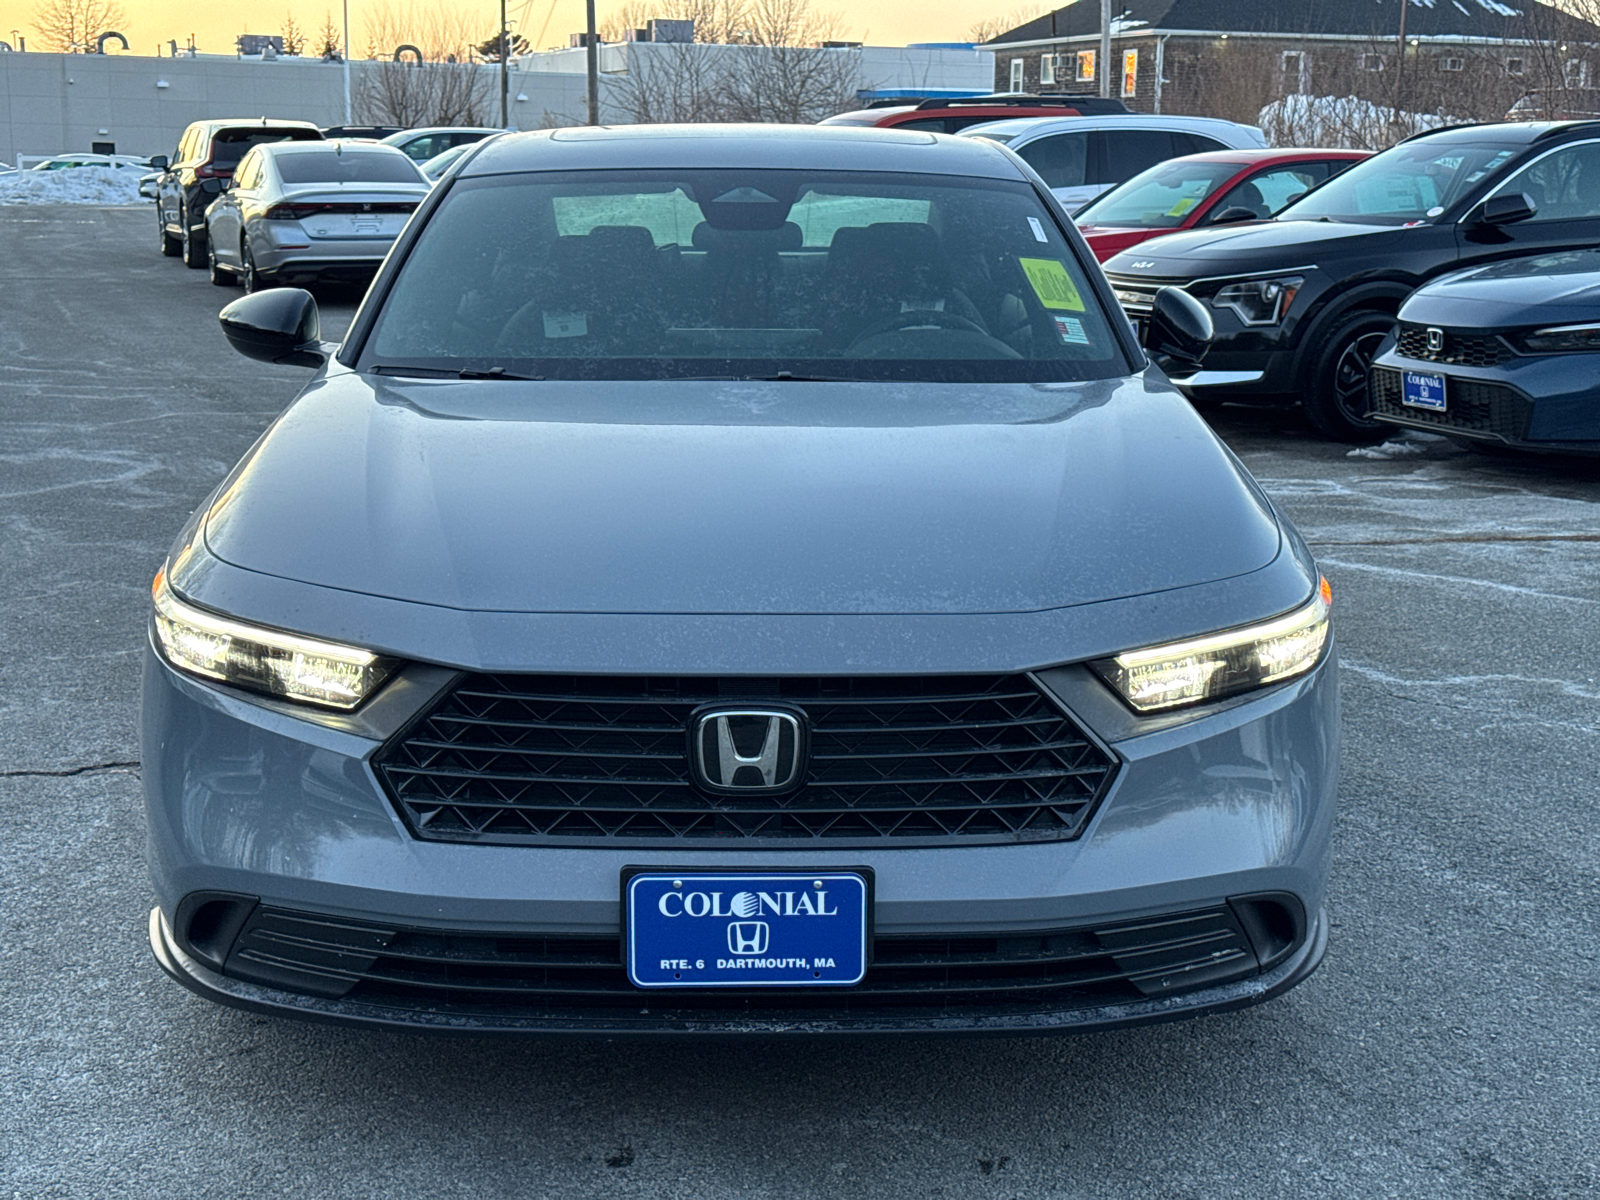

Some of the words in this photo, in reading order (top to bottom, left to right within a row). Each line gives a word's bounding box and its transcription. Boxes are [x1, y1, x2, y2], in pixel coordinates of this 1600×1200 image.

[658, 891, 838, 918] COLONIAL
[660, 959, 692, 970] RTE.
[696, 959, 705, 970] 6
[716, 958, 810, 970] DARTMOUTH,
[814, 957, 836, 968] MA
